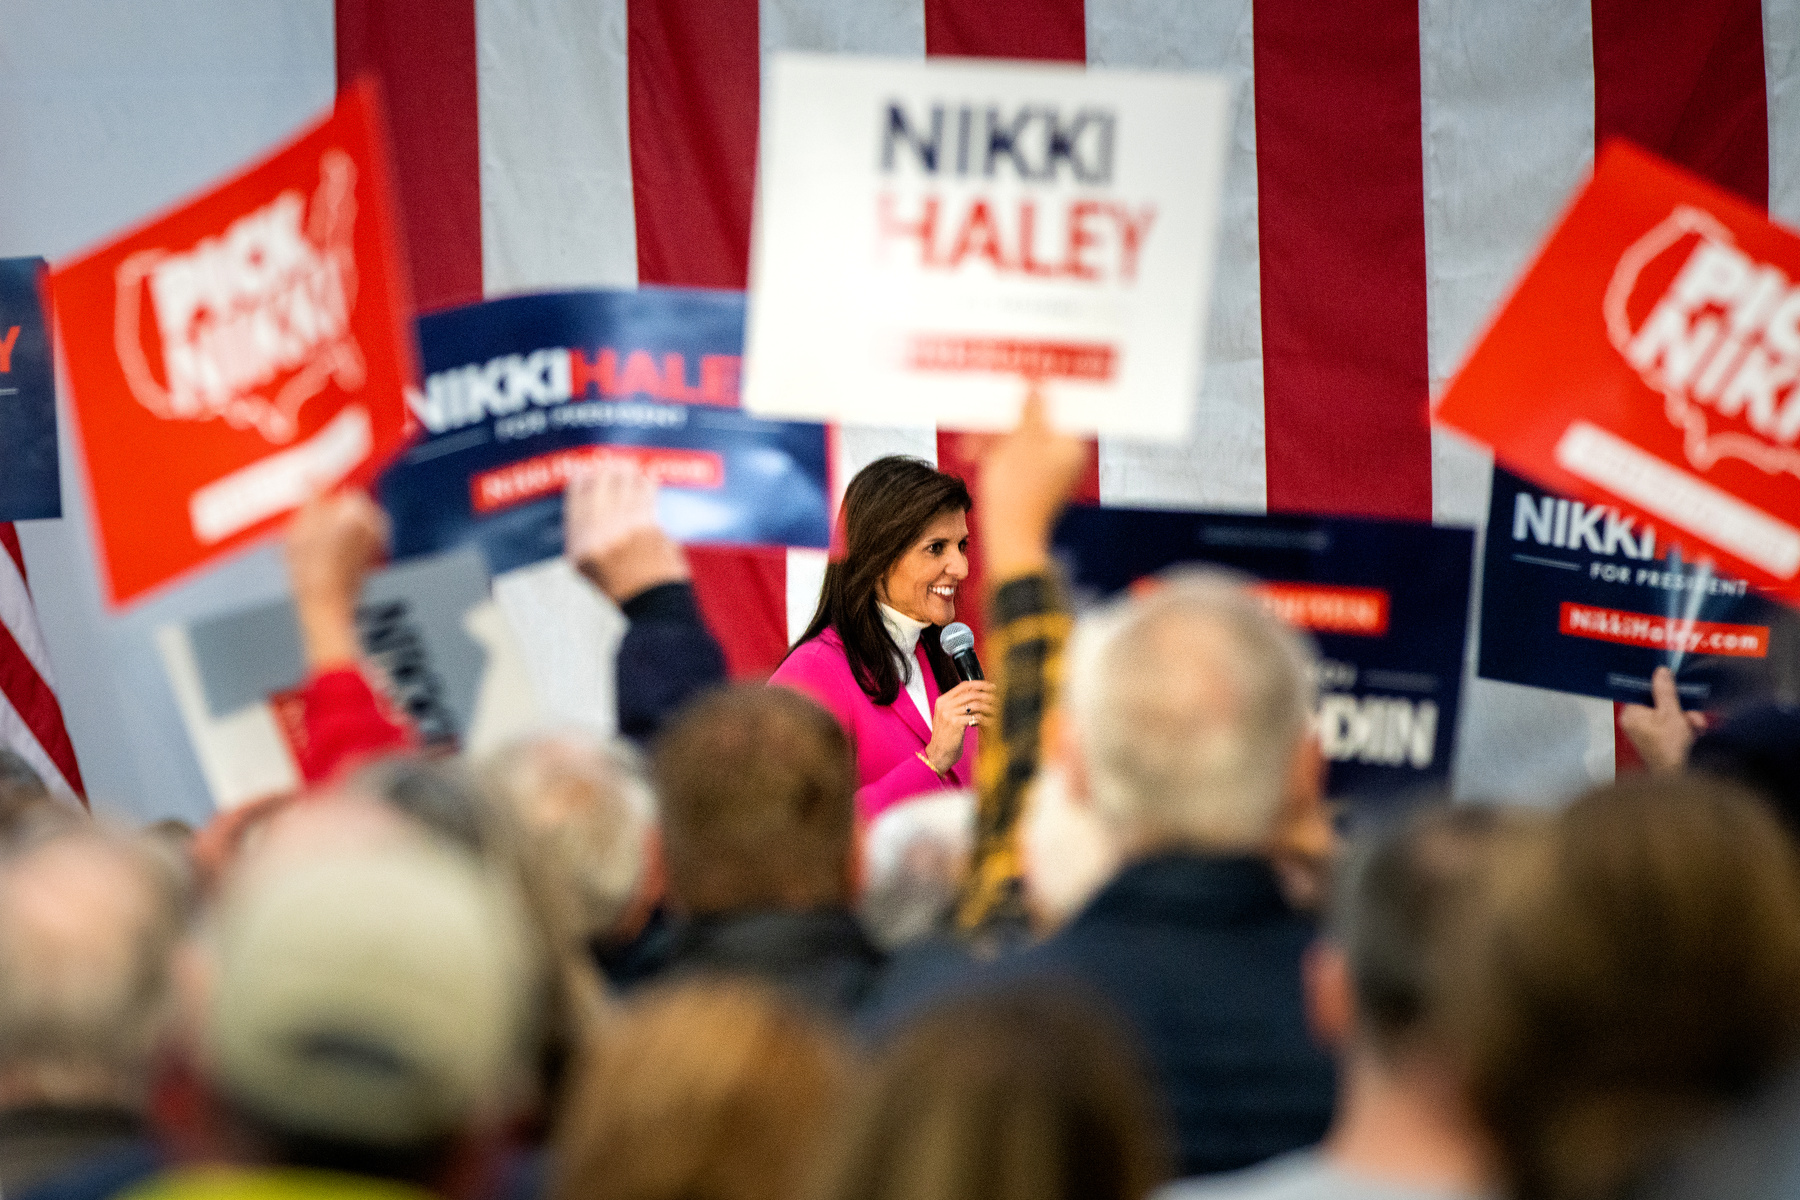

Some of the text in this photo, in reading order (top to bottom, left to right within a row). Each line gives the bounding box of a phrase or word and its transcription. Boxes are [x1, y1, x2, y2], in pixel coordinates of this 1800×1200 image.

[878, 97, 1117, 184] NIKKI
[875, 190, 1158, 288] HALEY
[1661, 240, 1800, 352] PIC
[569, 345, 745, 408] HALE
[1627, 298, 1800, 438] NIK
[1590, 562, 1631, 584] FOR
